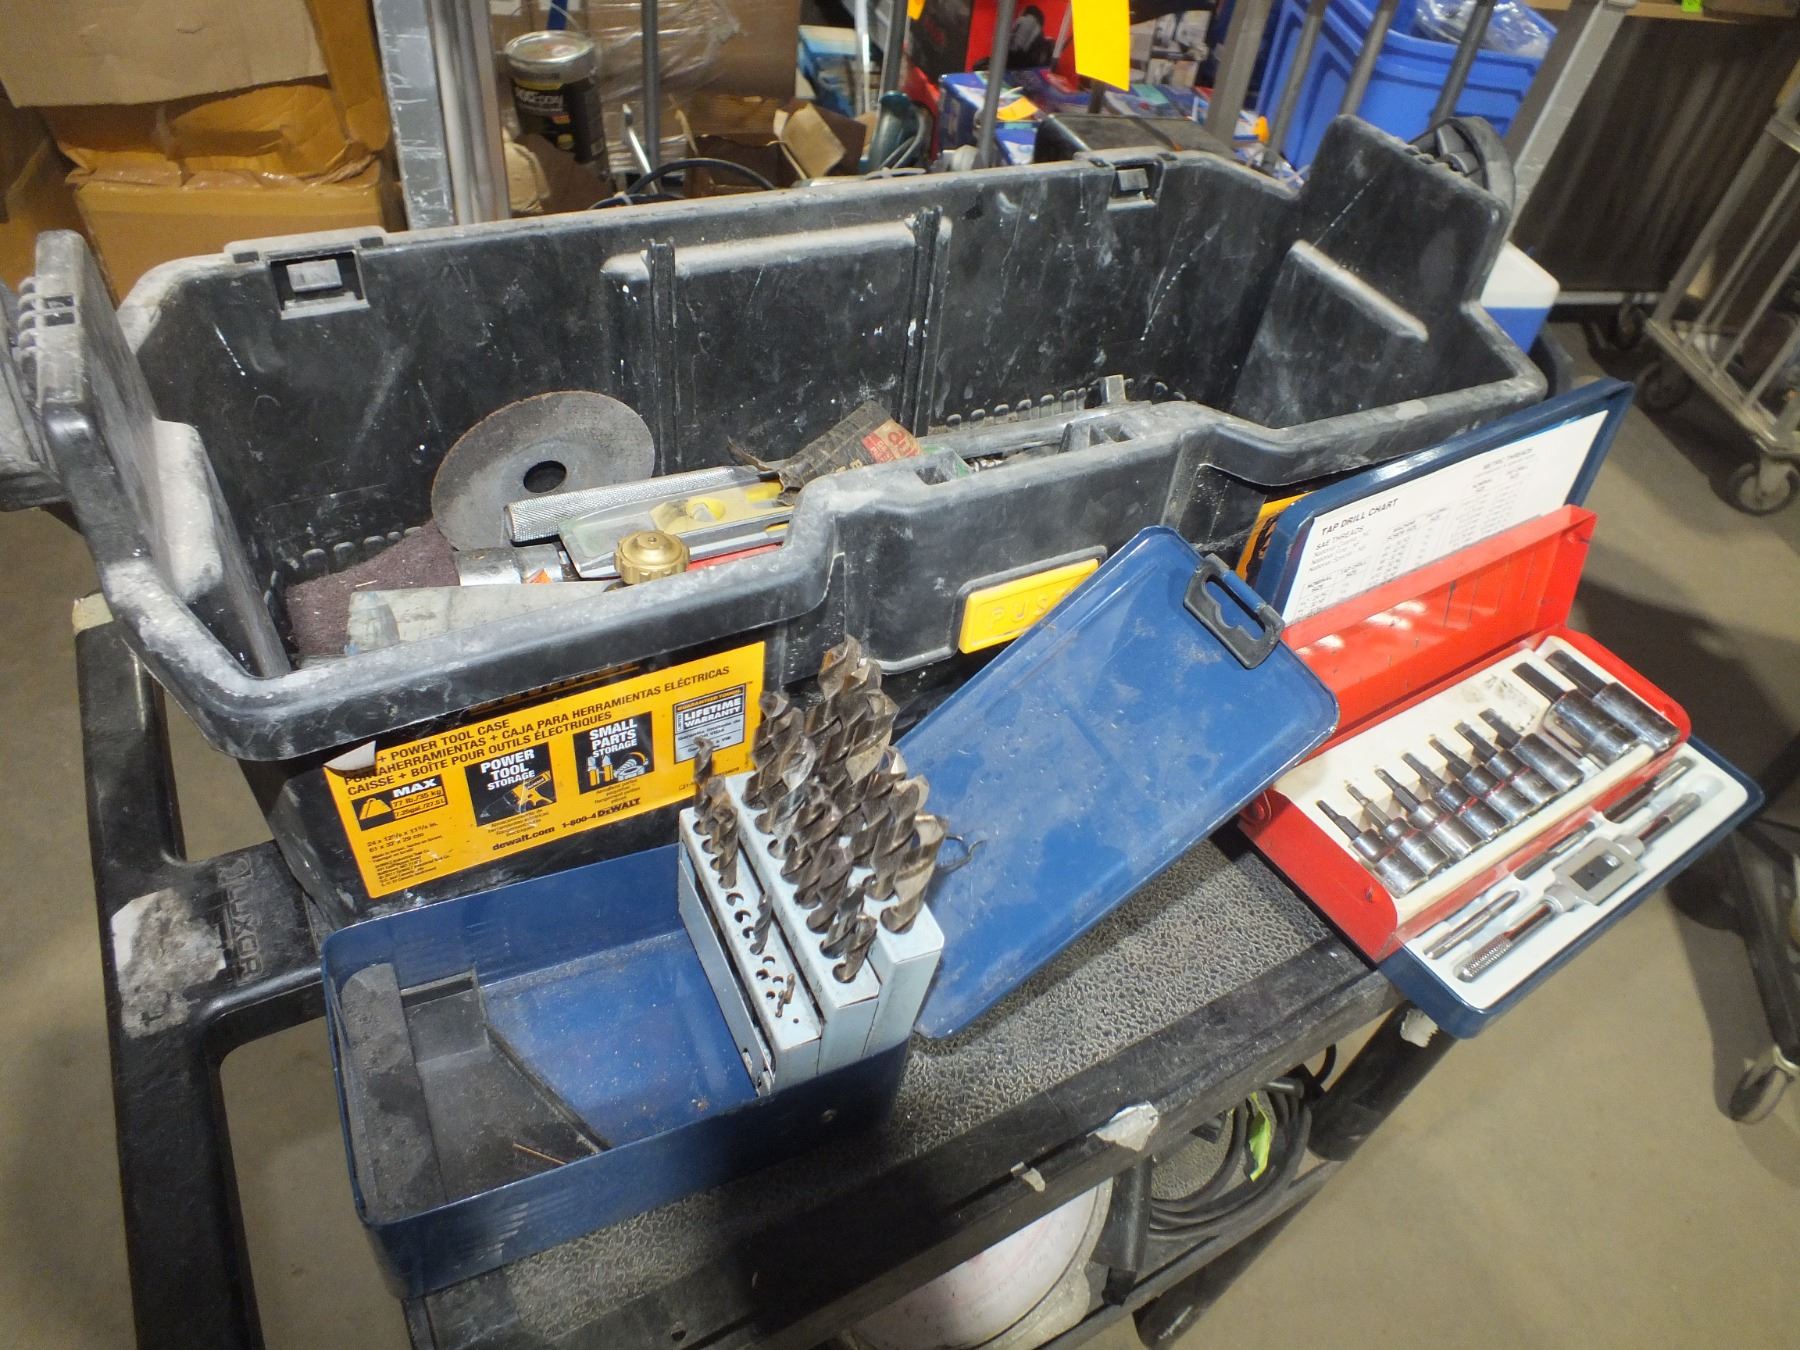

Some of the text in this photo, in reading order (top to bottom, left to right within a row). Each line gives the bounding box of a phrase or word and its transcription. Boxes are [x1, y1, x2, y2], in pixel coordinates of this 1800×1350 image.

[1321, 498, 1399, 537] TAP DRILL CHART
[502, 724, 534, 740] CAJA
[537, 712, 569, 729] PARA
[572, 686, 661, 719] HERRAMIENTAS
[664, 666, 730, 692] ELÉCTRICAS
[684, 698, 742, 721] LIFETIME
[684, 706, 740, 728] WARRANTY
[391, 739, 438, 761] POWER
[441, 731, 474, 746] TOOL
[478, 719, 510, 736] CASE
[589, 718, 638, 741] SMALL
[592, 729, 637, 751] PARTS
[347, 775, 396, 796] CAISSE
[411, 760, 448, 779] BOÎTE
[451, 749, 485, 765] POUR
[488, 736, 531, 756] OUTILS
[534, 711, 612, 741] ÉLECTRIQUES
[592, 739, 638, 758] STORAGE
[480, 748, 535, 774] POWER
[490, 762, 530, 781] TOOL
[392, 777, 438, 797] MAX
[487, 770, 536, 791] STORAGE
[492, 826, 556, 851] dewalt.com
